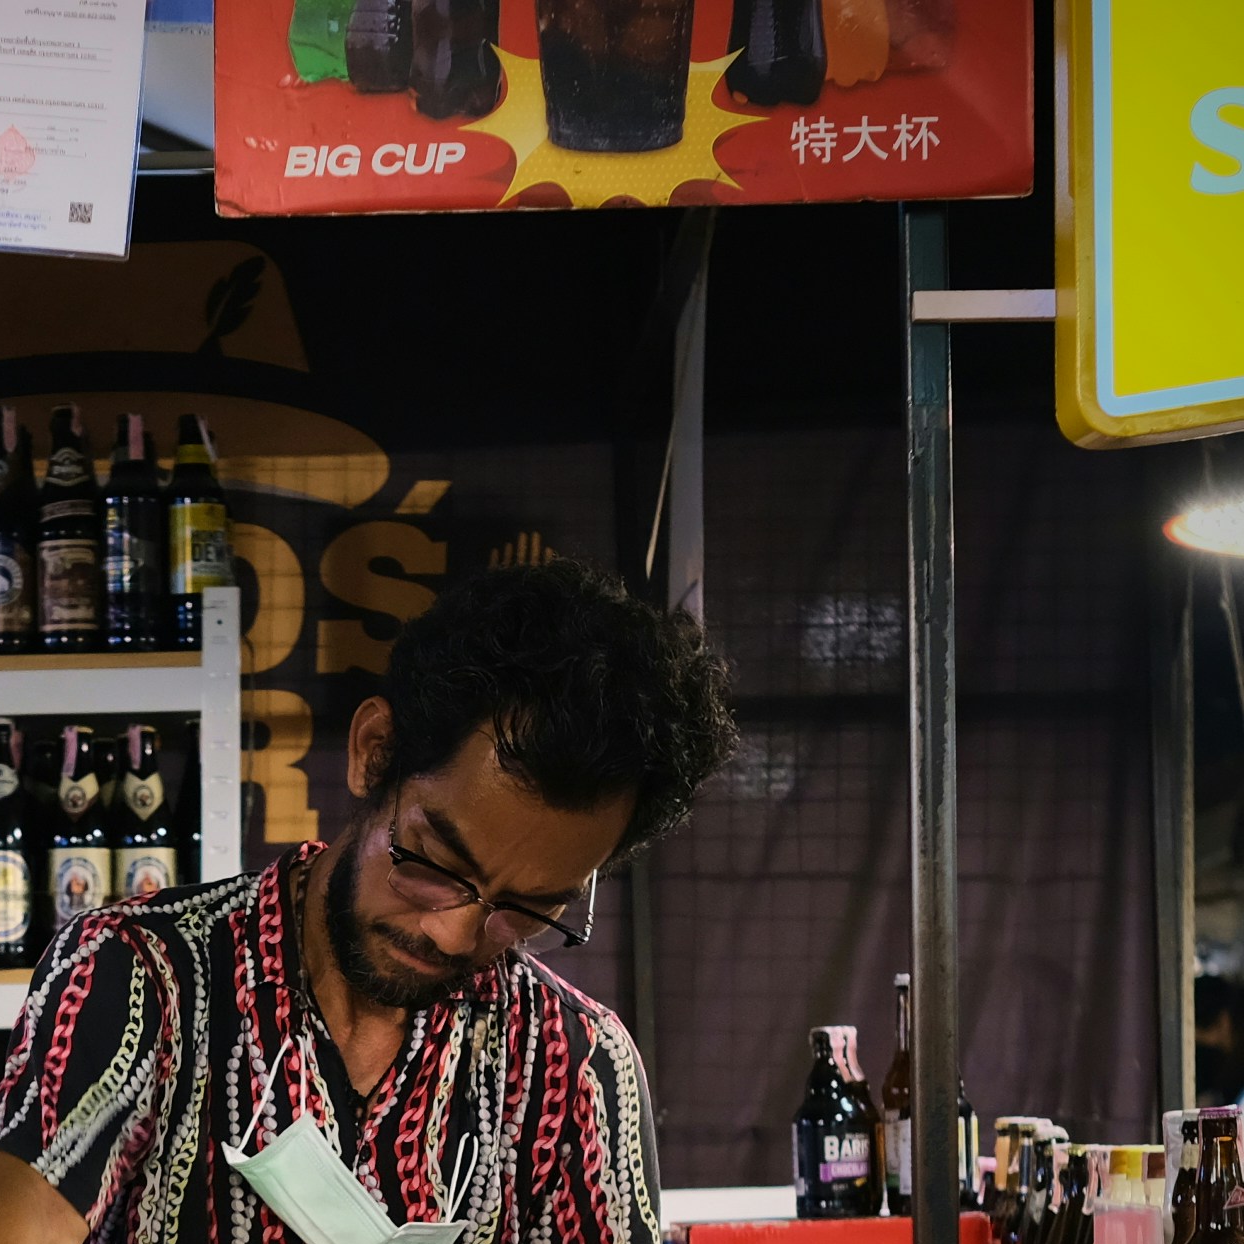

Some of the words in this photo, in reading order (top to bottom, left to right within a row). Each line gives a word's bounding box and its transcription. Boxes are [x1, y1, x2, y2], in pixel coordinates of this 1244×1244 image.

[284, 144, 361, 178] BIG
[370, 142, 466, 176] CUP
[789, 114, 941, 166] 特大杯
